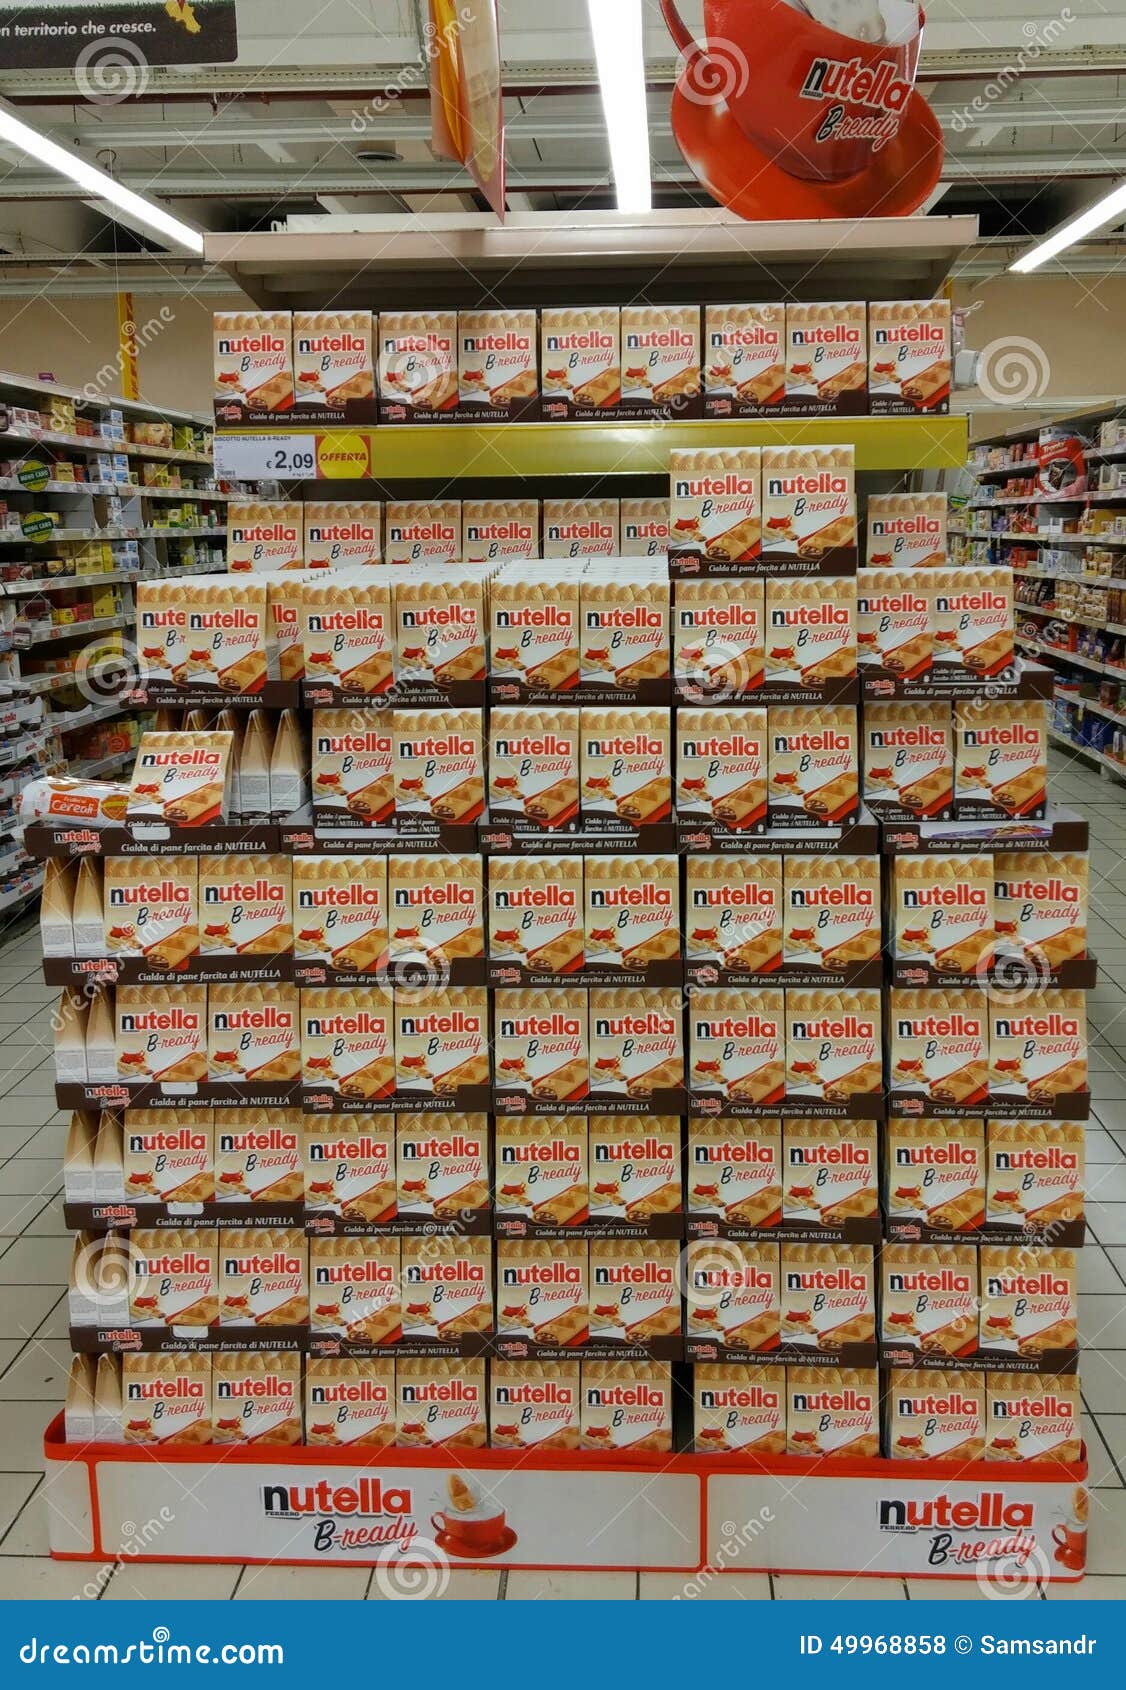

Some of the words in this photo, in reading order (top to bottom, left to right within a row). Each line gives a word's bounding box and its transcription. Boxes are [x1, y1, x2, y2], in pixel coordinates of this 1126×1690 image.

[15, 22, 76, 36] territorio
[81, 21, 105, 35] che
[109, 22, 157, 34] cresce.
[804, 60, 911, 111] nutella
[817, 106, 899, 151] B-ready
[299, 335, 364, 352] nutella
[464, 334, 529, 351] nutella
[626, 330, 693, 348] nutella
[792, 326, 859, 344] nutella
[875, 325, 942, 343] nutella
[219, 336, 284, 353] nutella
[814, 345, 861, 363] B-ready
[897, 344, 944, 362] B-ready
[241, 354, 286, 371] B-ready
[321, 353, 366, 370] B-ready
[486, 352, 531, 369] B-ready
[648, 349, 695, 367] B-ready
[275, 450, 313, 471] 2,09
[320, 453, 367, 462] OFFERTA
[676, 477, 752, 497] nutella
[770, 475, 846, 495] nutella
[701, 498, 754, 518] B-ready
[795, 496, 848, 516] B-ready
[231, 525, 296, 542] nutella
[309, 524, 374, 541] nutella
[873, 517, 938, 534] nutella
[253, 543, 298, 560] B-ready
[331, 542, 376, 559] B-ready
[895, 535, 940, 552] B-ready
[936, 592, 1005, 611] nutella
[190, 611, 257, 629] nutella
[309, 612, 382, 631] nutella
[497, 608, 570, 627] nutella
[772, 606, 848, 626] nutella
[959, 612, 1007, 630] B-ready
[212, 630, 259, 648] B-ready
[333, 632, 384, 652] B-ready
[521, 628, 572, 648] B-ready
[797, 627, 850, 647] B-ready
[774, 732, 850, 752] nutella
[963, 726, 1039, 746] nutella
[401, 738, 474, 757] nutella
[496, 737, 569, 756] nutella
[588, 737, 661, 756] nutella
[142, 750, 220, 766] nutella
[520, 757, 571, 777] B-ready
[612, 757, 663, 777] B-ready
[799, 753, 852, 773] B-ready
[988, 747, 1041, 767] B-ready
[163, 765, 219, 783] B-ready
[425, 758, 476, 778] B-ready
[150, 843, 159, 851] di
[214, 842, 223, 850] di
[225, 841, 266, 850] NUTELLA
[205, 882, 283, 902] nutella
[300, 886, 378, 906] nutella
[496, 887, 574, 907] nutella
[791, 885, 871, 906] nutella
[903, 885, 985, 907] nutella
[230, 903, 285, 924] B-ready
[325, 907, 380, 928] B-ready
[521, 908, 576, 929] B-ready
[817, 907, 873, 928] B-ready
[930, 908, 988, 930] B-ready
[167, 972, 175, 981] di
[229, 971, 238, 980] di
[240, 970, 280, 979] NUTELLA
[122, 1011, 198, 1031] nutella
[215, 1010, 291, 1030] nutella
[501, 1016, 579, 1036] nutella
[793, 1018, 873, 1039] nutella
[899, 1016, 979, 1037] nutella
[147, 1032, 200, 1052] B-ready
[240, 1031, 293, 1051] B-ready
[526, 1037, 581, 1058] B-ready
[819, 1040, 875, 1061] B-ready
[925, 1038, 981, 1059] B-ready
[178, 1098, 186, 1106] di
[239, 1097, 248, 1105] di
[250, 1097, 290, 1105] NUTELLA
[130, 1132, 206, 1152] nutella
[311, 1140, 387, 1160] nutella
[595, 1140, 673, 1160] nutella
[155, 1153, 208, 1173] B-ready
[896, 1144, 976, 1165] nutella
[336, 1161, 389, 1181] B-ready
[620, 1161, 675, 1182] B-ready
[922, 1166, 978, 1187] B-ready
[184, 1217, 192, 1226] di
[245, 1217, 253, 1225] di
[255, 1217, 294, 1225] NUTELLA
[226, 1256, 299, 1275] nutella
[504, 1265, 580, 1285] nutella
[250, 1276, 301, 1296] B-ready
[788, 1270, 866, 1290] nutella
[529, 1286, 582, 1306] B-ready
[813, 1291, 868, 1312] B-ready
[129, 1380, 202, 1399] nutella
[403, 1383, 476, 1402] nutella
[496, 1384, 572, 1404] nutella
[153, 1400, 204, 1420] B-ready
[793, 1391, 871, 1411] nutella
[994, 1397, 1072, 1417] nutella
[427, 1403, 478, 1423] B-ready
[521, 1405, 574, 1425] B-ready
[818, 1412, 873, 1433] B-ready
[1019, 1418, 1074, 1439] B-ready
[263, 1477, 411, 1513] nutella
[880, 1493, 1033, 1526] nutella
[314, 1516, 418, 1551] B-ready
[929, 1529, 1036, 1566] B-ready
